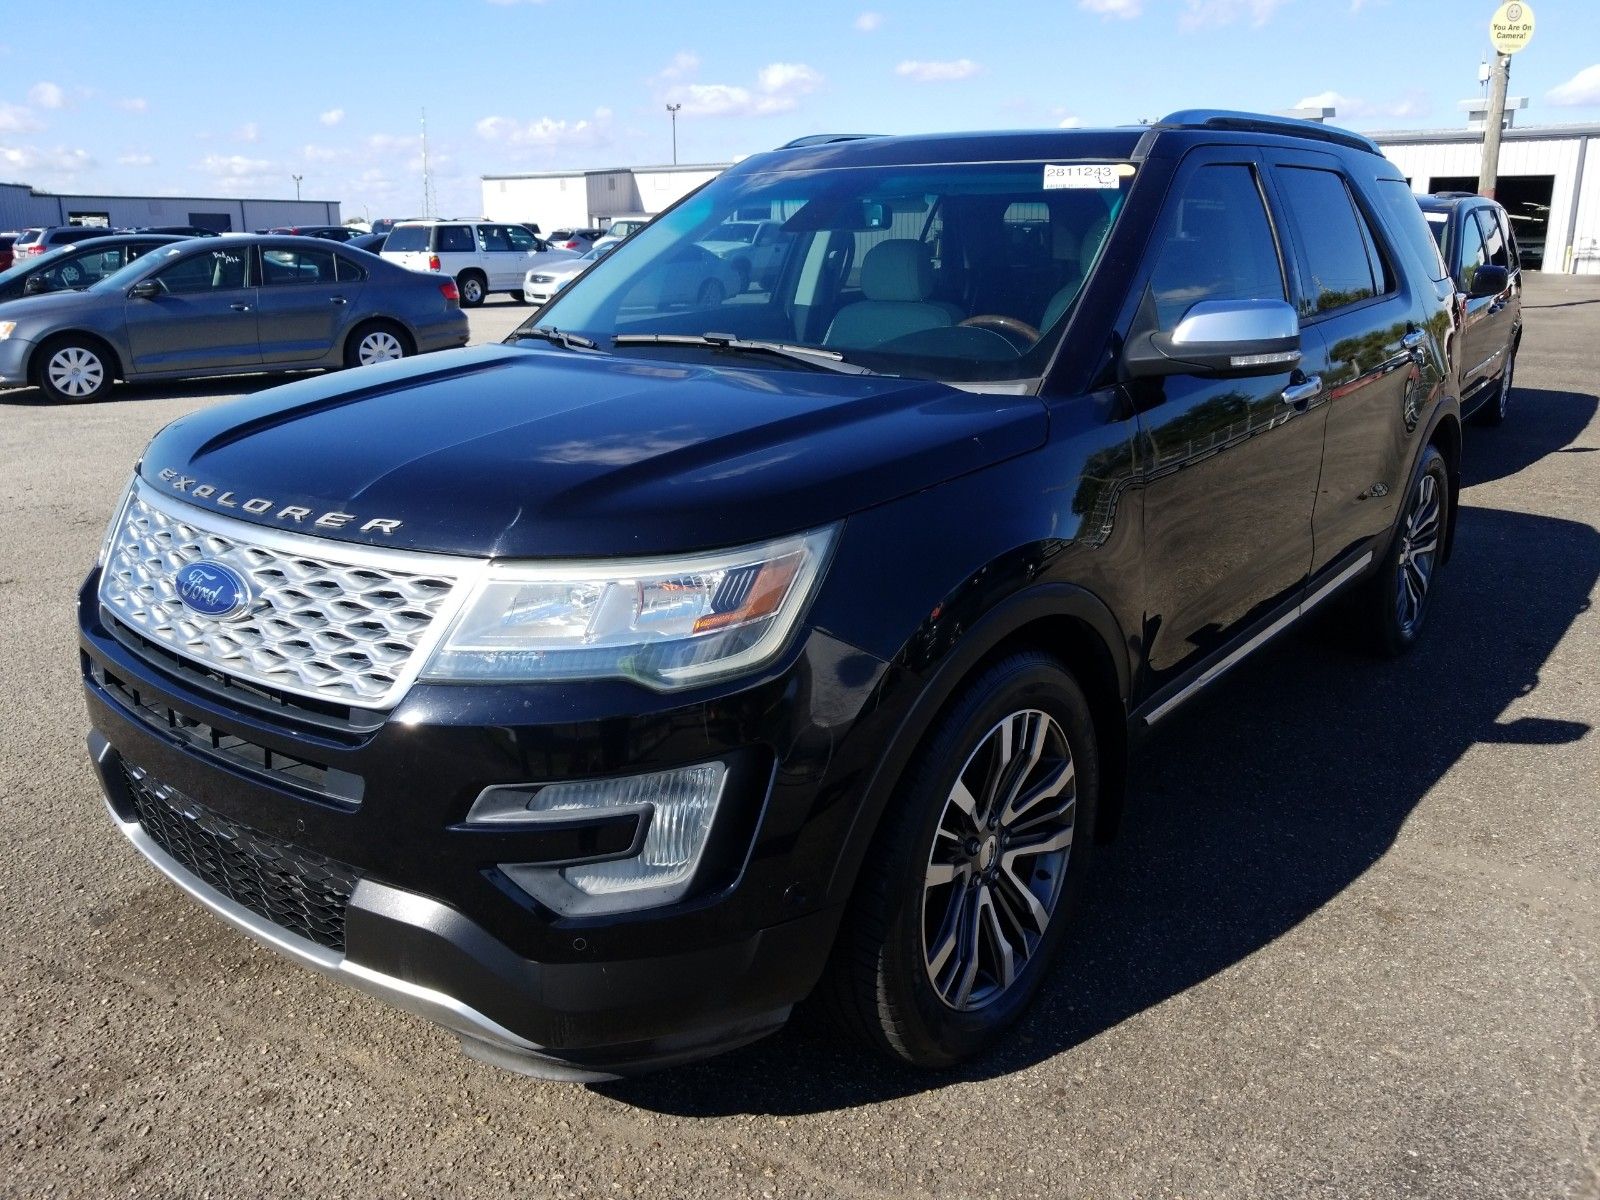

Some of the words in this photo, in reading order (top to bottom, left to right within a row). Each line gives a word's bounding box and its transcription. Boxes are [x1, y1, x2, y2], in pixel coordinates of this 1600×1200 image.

[1046, 166, 1112, 177] 2811243
[157, 467, 404, 534] EXPLORER
[181, 568, 224, 606] Ford
